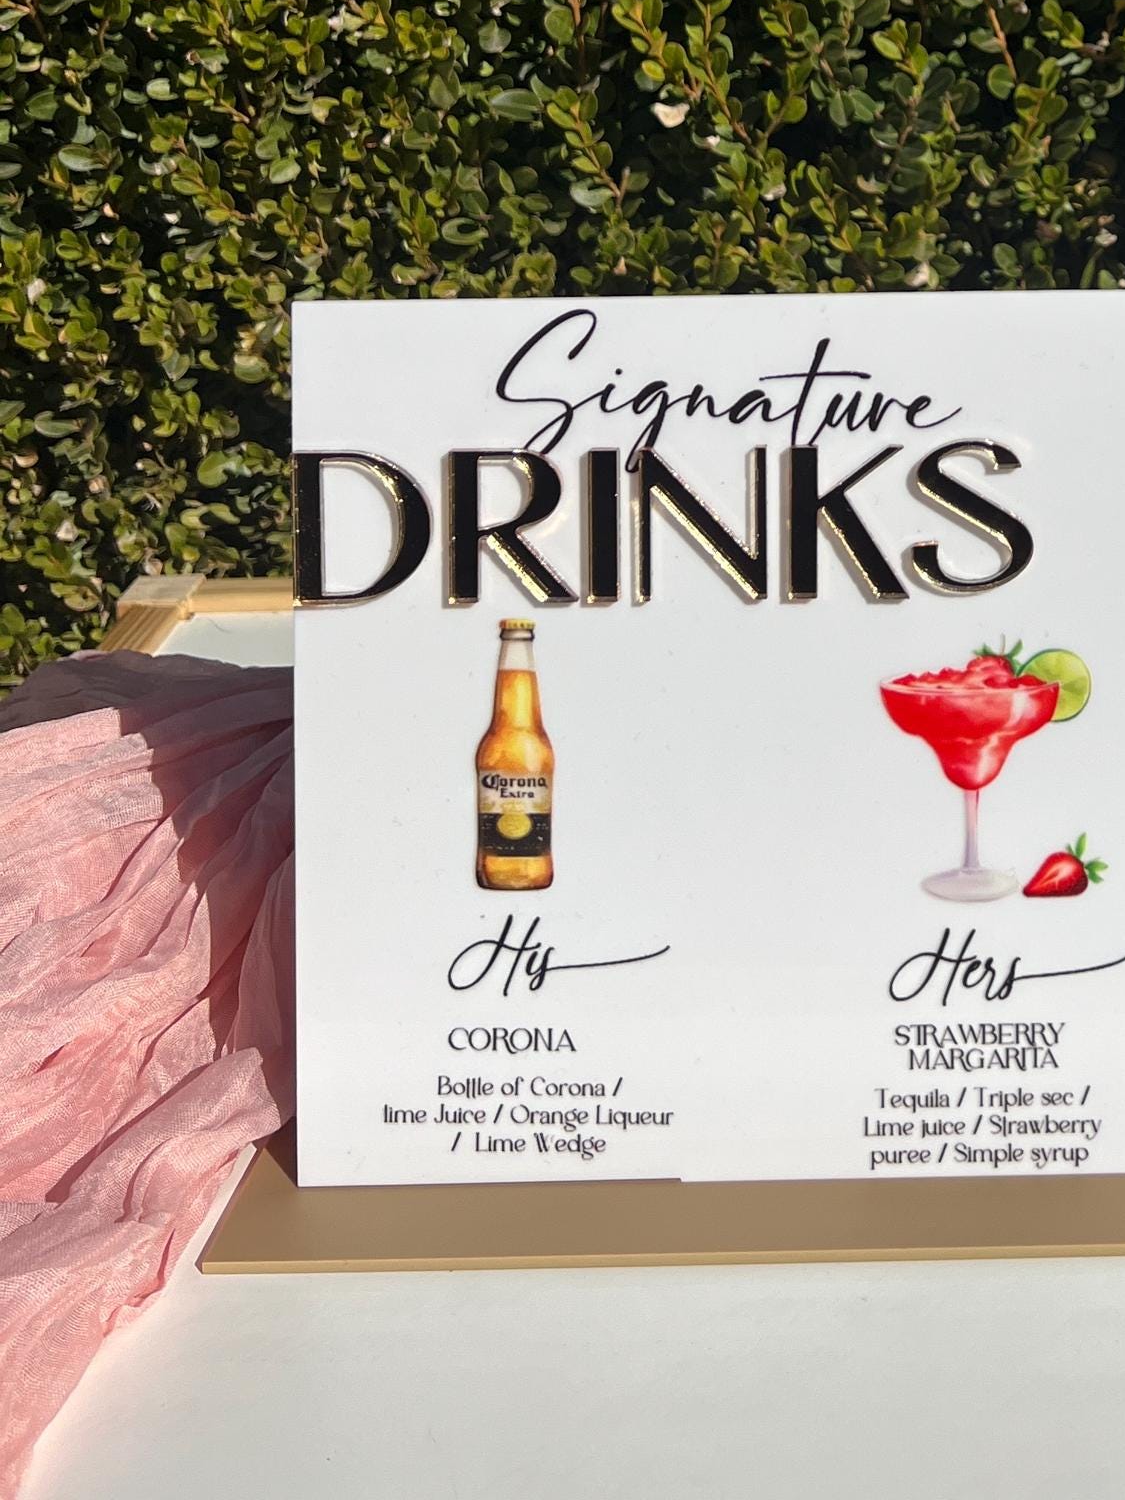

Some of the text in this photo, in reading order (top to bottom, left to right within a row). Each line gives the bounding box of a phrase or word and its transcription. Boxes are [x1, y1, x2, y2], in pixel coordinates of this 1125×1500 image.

[496, 309, 961, 472] Signature
[292, 439, 1034, 606] DRINKS
[481, 774, 547, 790] Corona
[500, 788, 534, 798] Extra
[448, 914, 670, 996] His
[448, 1028, 576, 1053] CORONA
[894, 1023, 1066, 1048] STRAWBERRY
[909, 1048, 1059, 1071] MARGARITA
[438, 1076, 493, 1099] Bottle
[501, 1077, 524, 1096] of
[531, 1077, 605, 1096] Corona
[874, 1088, 950, 1113] Tequila
[974, 1087, 1034, 1112] Triple
[1041, 1091, 1073, 1105] sec
[434, 1104, 486, 1123] Juice
[511, 1105, 588, 1132] Orange
[596, 1105, 673, 1129] Liqueur
[864, 1117, 914, 1136] Lime
[922, 1118, 966, 1138] juice
[989, 1115, 1102, 1140] Strawberry
[476, 1133, 526, 1152] Lime
[534, 1132, 606, 1160] Wedge
[871, 1148, 931, 1169] puree
[954, 1143, 1023, 1168] Simple
[1031, 1147, 1089, 1169] syrup
